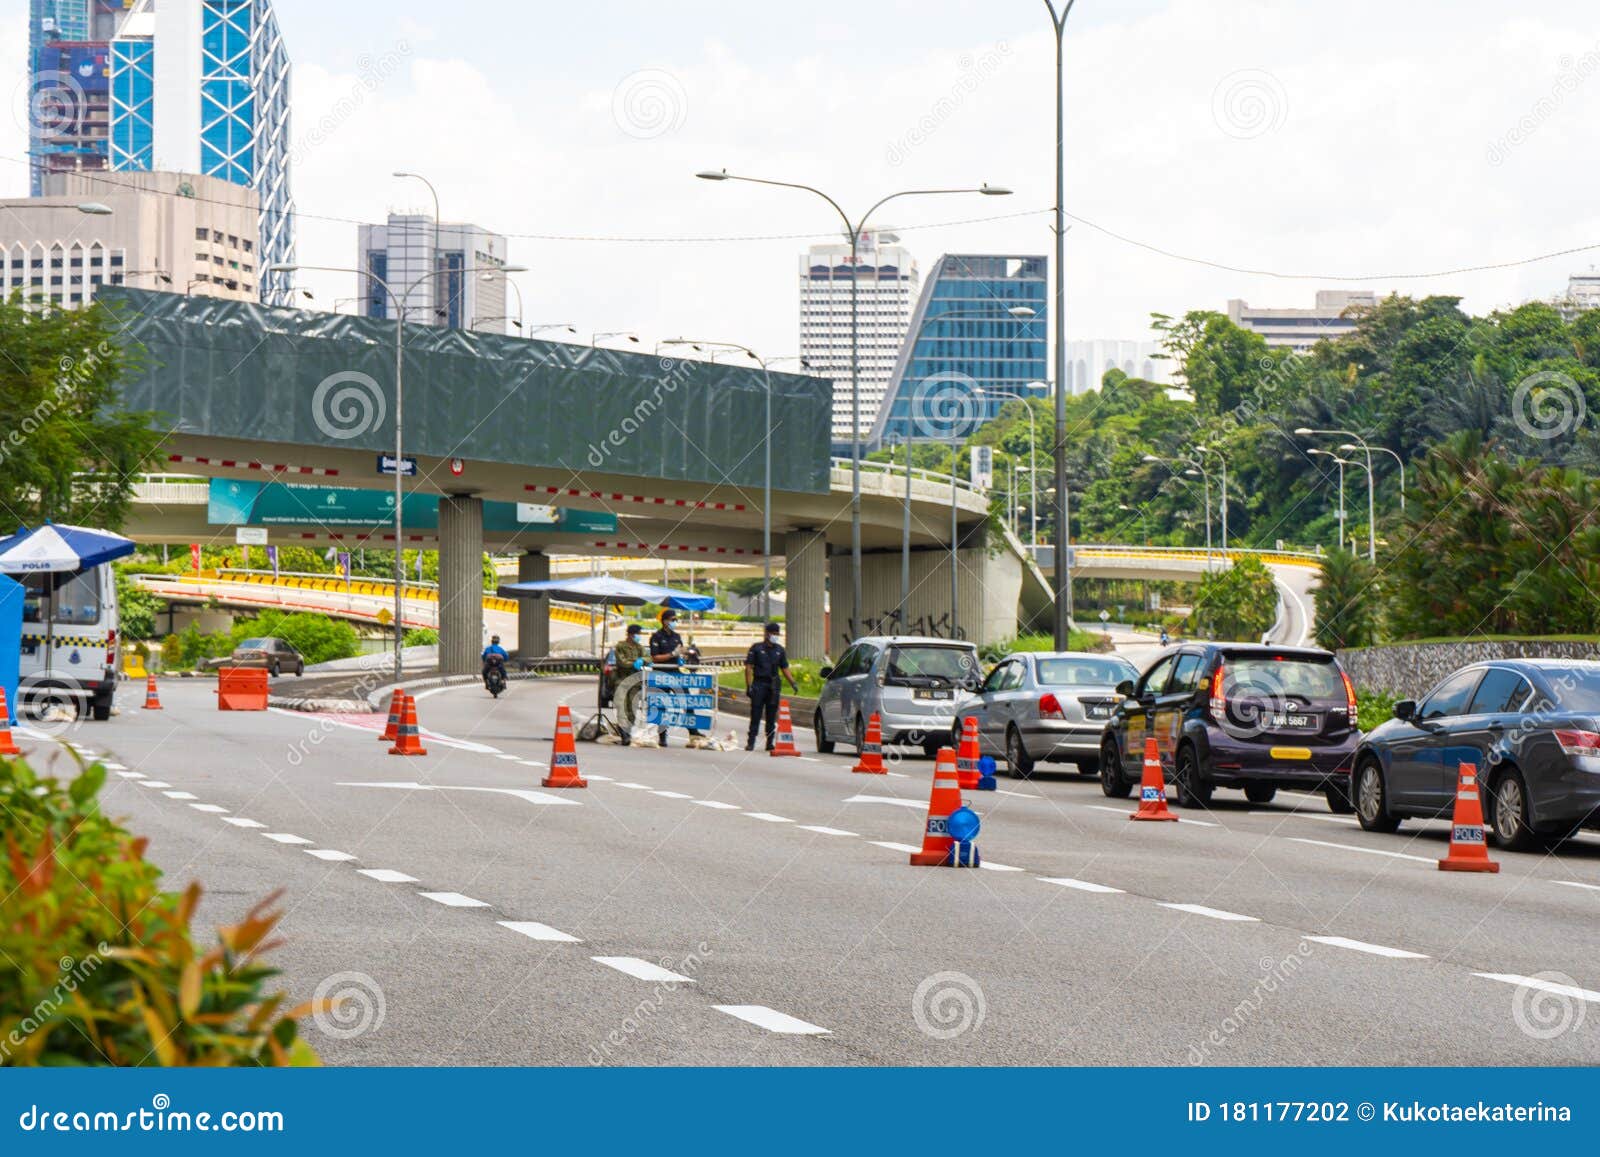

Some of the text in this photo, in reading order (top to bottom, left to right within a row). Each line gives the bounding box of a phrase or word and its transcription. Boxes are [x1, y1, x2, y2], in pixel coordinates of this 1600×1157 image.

[655, 675, 706, 686] BERHENTI
[661, 713, 697, 726] POLIS
[1455, 828, 1483, 840] POLIS
